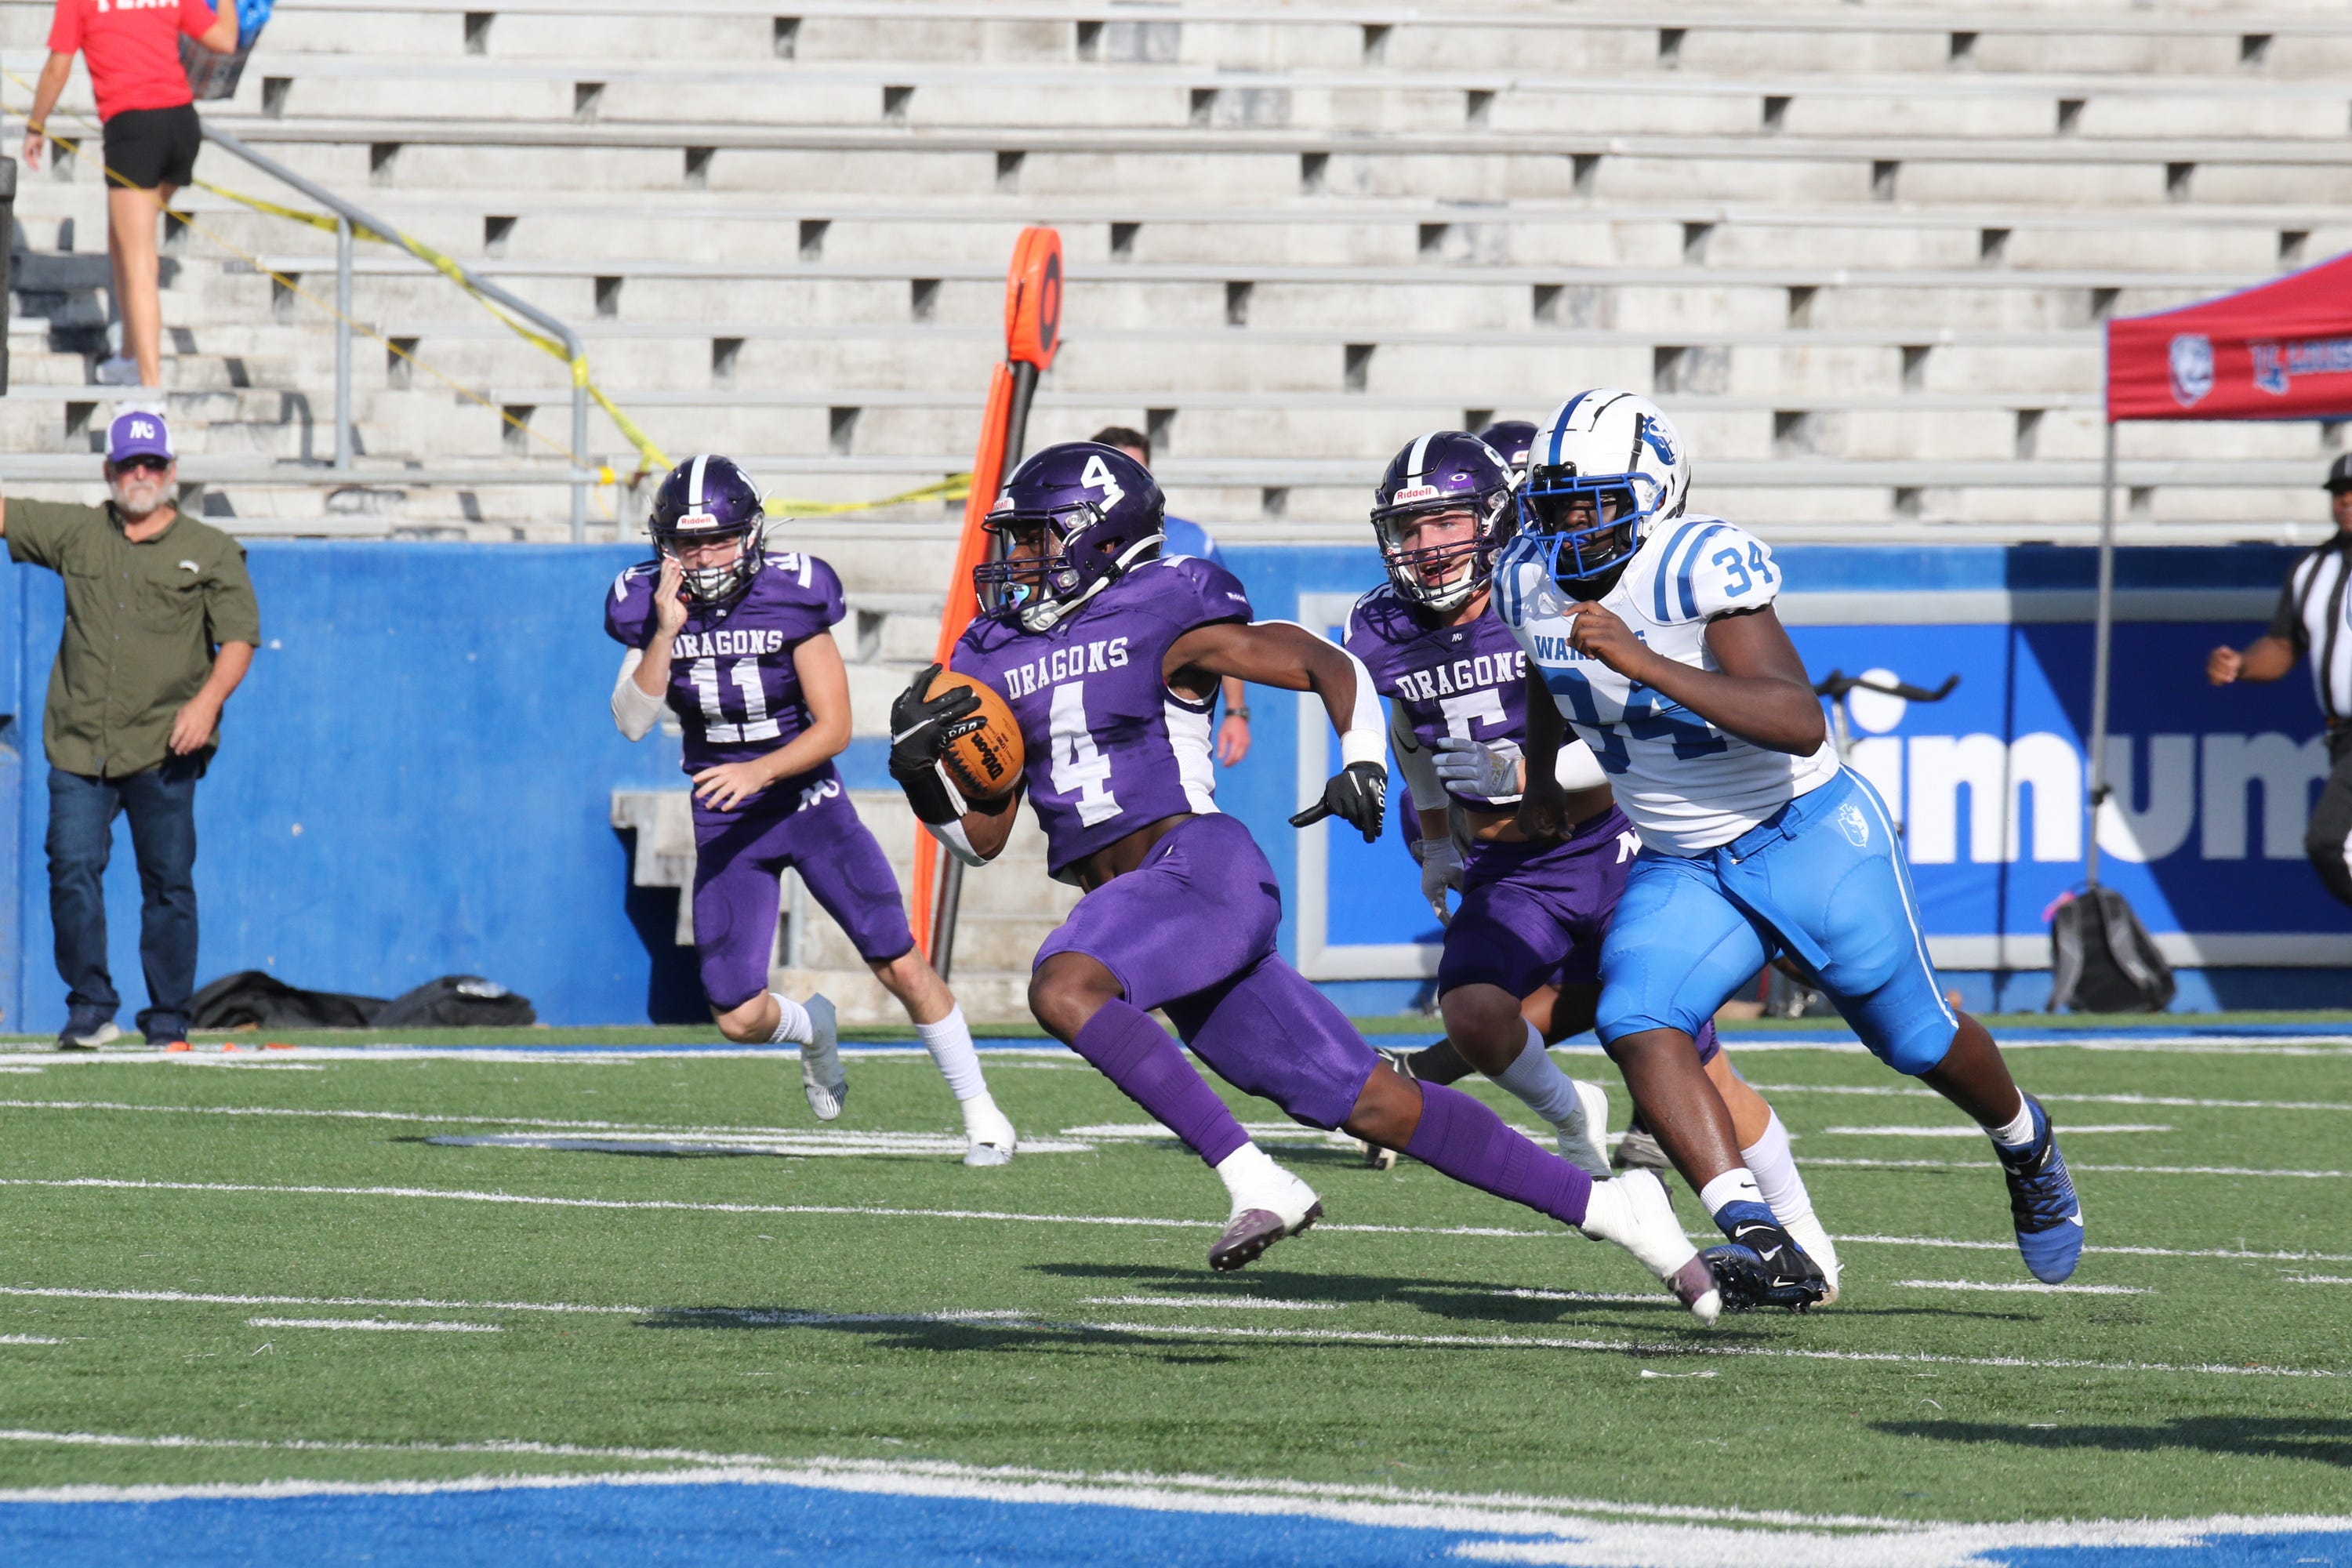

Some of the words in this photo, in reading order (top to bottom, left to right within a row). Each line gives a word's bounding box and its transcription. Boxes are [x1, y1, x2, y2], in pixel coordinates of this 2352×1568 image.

[1080, 455, 1120, 495] 4
[1397, 487, 1432, 499] Riddell
[681, 517, 711, 525] Riddell
[1711, 541, 1773, 597] 34
[671, 630, 783, 659] DRAGONS
[1004, 637, 1129, 700] DRAGONS
[689, 657, 781, 743] 11
[1396, 651, 1526, 702] DRAGONS
[971, 732, 1004, 781] Wilson
[1049, 681, 1123, 828] 4
